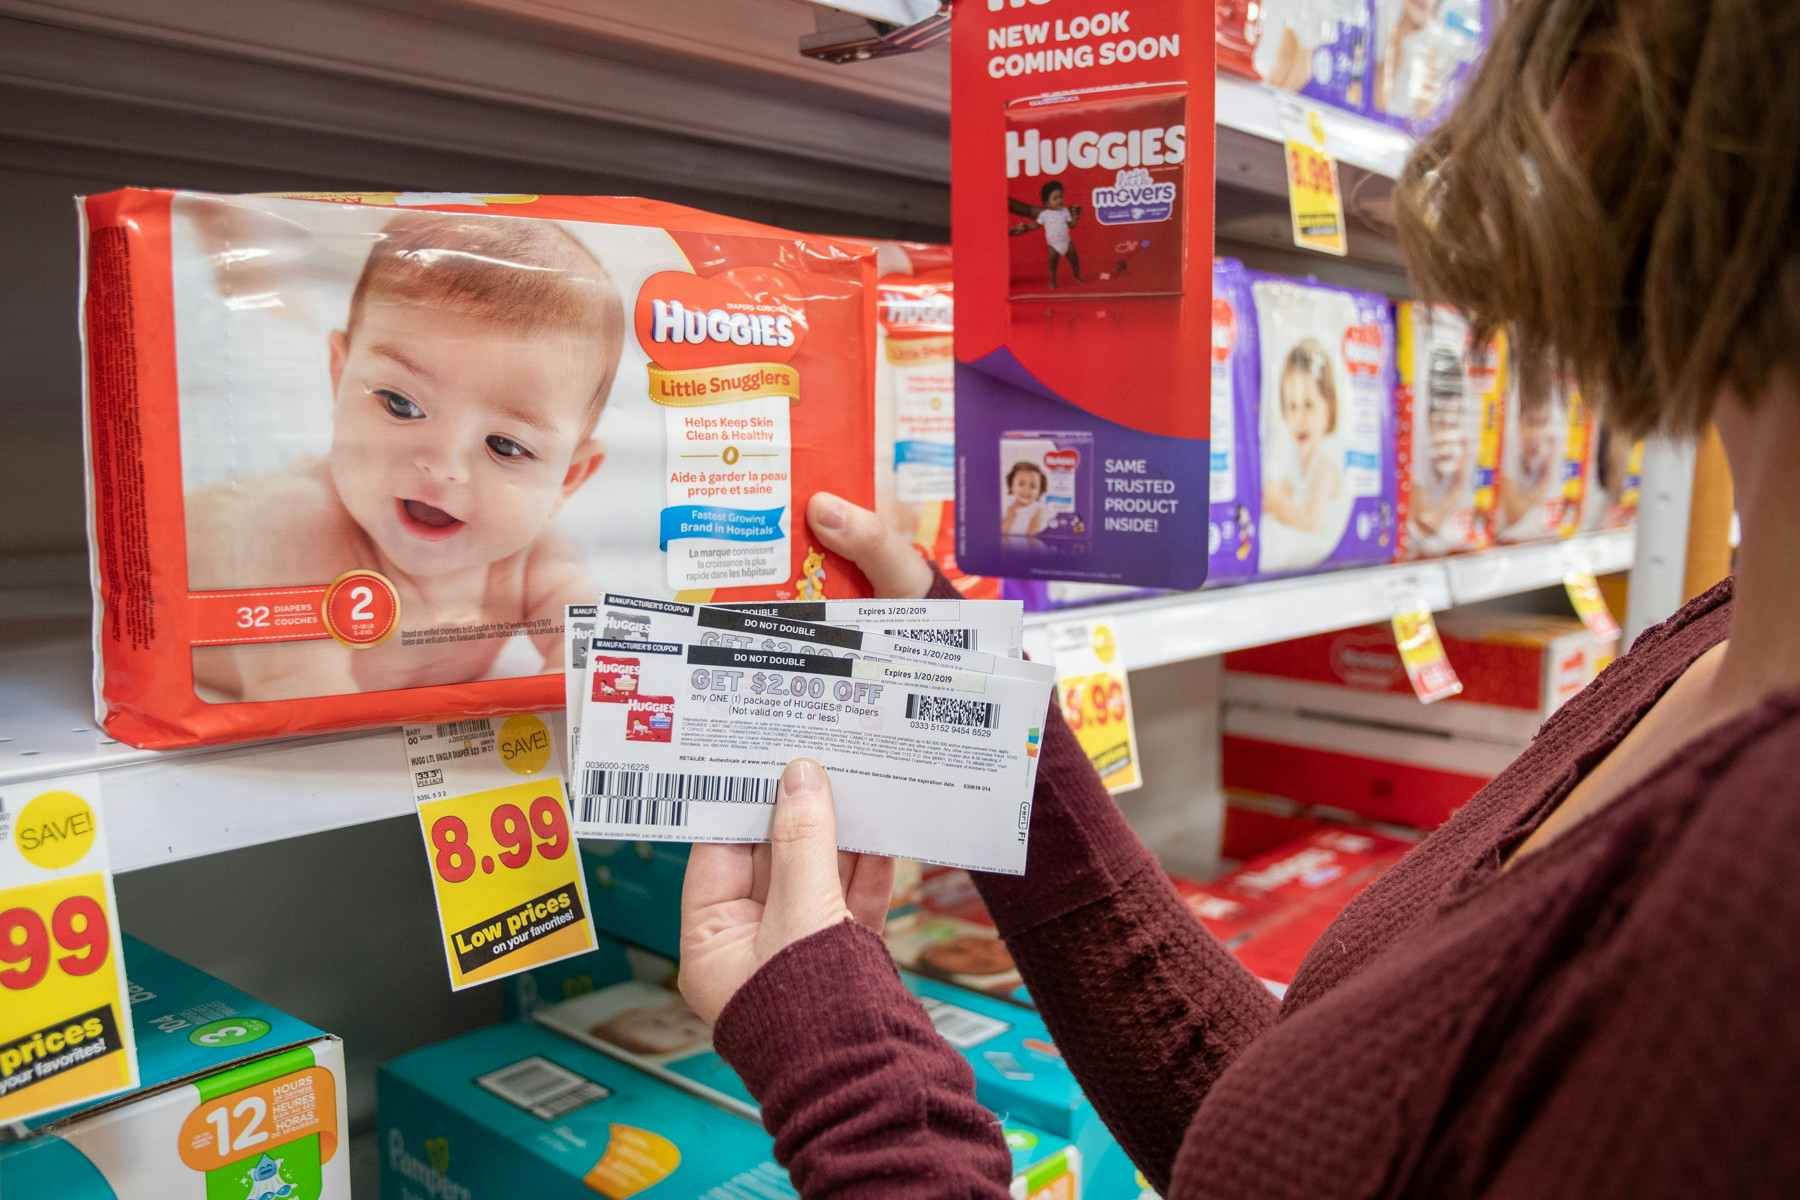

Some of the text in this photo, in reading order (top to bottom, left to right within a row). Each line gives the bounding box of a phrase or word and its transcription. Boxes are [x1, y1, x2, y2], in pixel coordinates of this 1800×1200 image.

[988, 10, 1131, 51] NEW LOOK
[988, 34, 1181, 79] COMING SOON
[1005, 125, 1186, 178] HUGGIES
[1095, 185, 1173, 205] movers
[652, 299, 795, 347] HUGGIES
[661, 369, 790, 398] Little Snugglers
[685, 417, 774, 429] Helps Keep Skin
[686, 430, 774, 442] Clean & Healthy
[1104, 459, 1147, 474] SAME
[671, 471, 787, 484] Aide à garder la peau
[1104, 479, 1176, 495] TRUSTED
[687, 484, 773, 498] propre et saine
[1104, 497, 1179, 515] PRODUCT
[691, 510, 766, 525] Fastest Growing
[1104, 517, 1159, 533] INSIDE!
[680, 523, 773, 537] Brand in Hospitals
[689, 549, 699, 559] La
[350, 587, 374, 621] 2
[609, 596, 690, 614] MANUFACTURER'S COUPON
[858, 607, 927, 617] Expires 3/20/2019
[236, 604, 318, 628] 32 DIAPERS COUCHES
[744, 619, 817, 637] DO NOT DOUBLE
[596, 641, 679, 653] MANUFACTURER'S COUPON
[893, 643, 962, 662] Expires 3/20/2019
[733, 653, 806, 667] DO NOT DOUBLE
[884, 668, 953, 684] Expires 3/20/2019
[690, 668, 744, 692] GET
[750, 671, 825, 699] $2.00
[833, 680, 884, 705] OFF
[691, 694, 707, 703] any
[709, 693, 729, 703] ONE
[731, 693, 741, 705] (1)
[743, 696, 780, 708] package
[783, 699, 792, 707] of
[845, 704, 879, 717] Diapers
[729, 704, 748, 716] (Not
[750, 707, 771, 717] valid
[773, 710, 784, 718] on
[786, 709, 793, 718] 9
[807, 712, 817, 720] or
[818, 713, 840, 725] less)
[910, 720, 929, 730] 0333
[502, 730, 549, 761] SAVE!
[20, 811, 94, 850] SAVE!
[431, 795, 569, 883] 8.99
[455, 892, 571, 954] Low prices
[492, 909, 575, 954] on your favorites!
[199, 1025, 247, 1044] 3
[0, 1017, 104, 1077] prices
[0, 1037, 107, 1096] your favorites!
[272, 1075, 313, 1096] HOURS
[205, 1096, 270, 1157] 12
